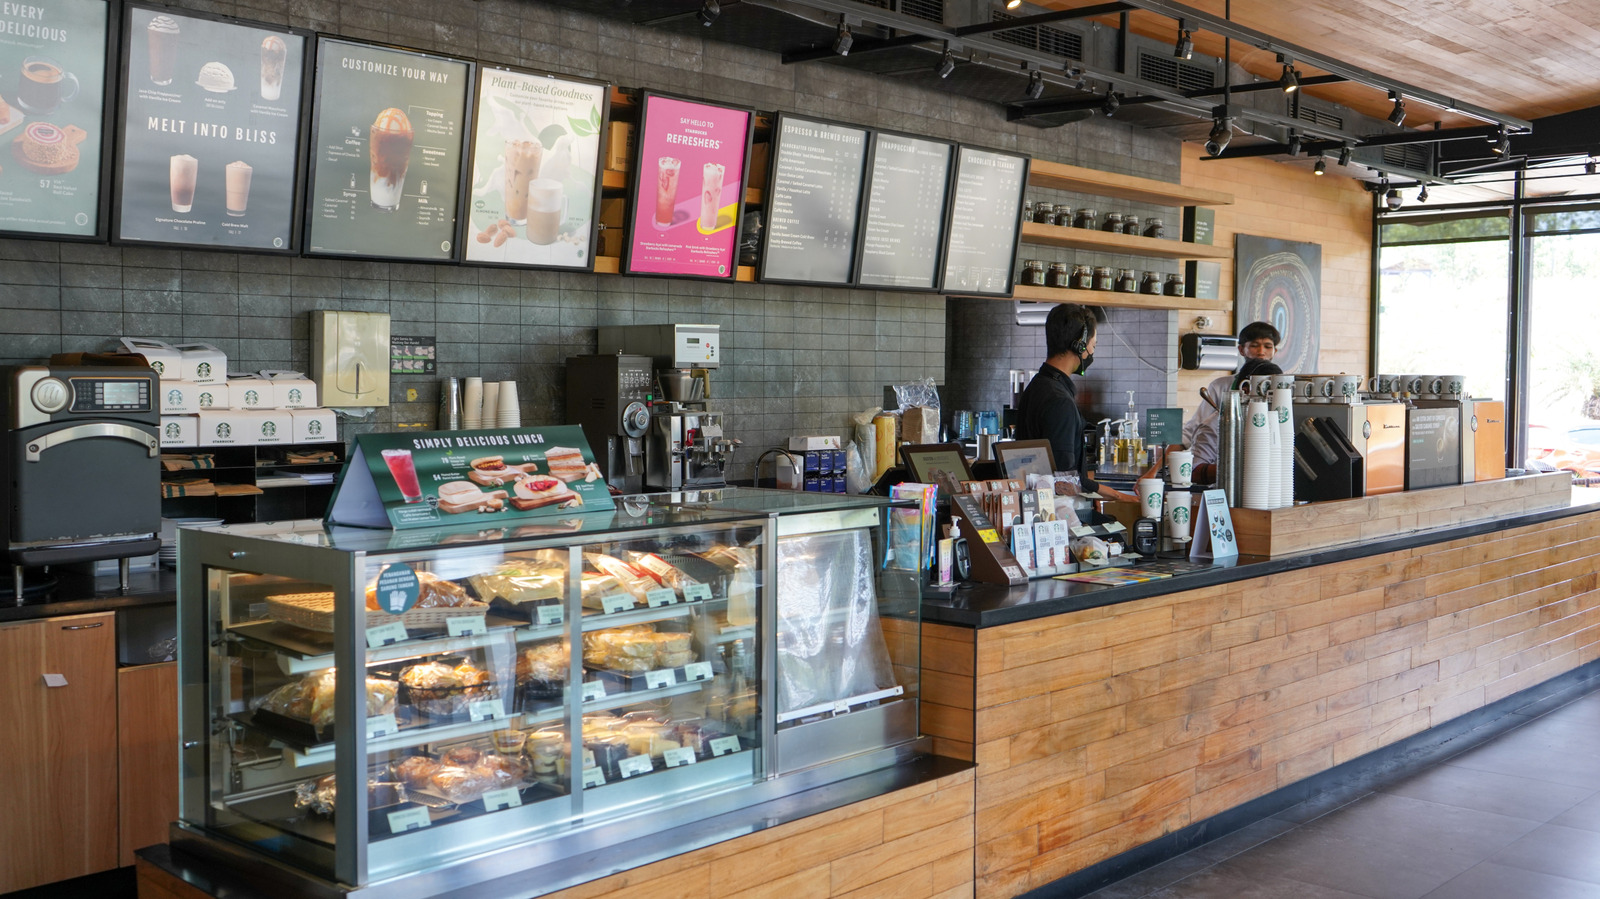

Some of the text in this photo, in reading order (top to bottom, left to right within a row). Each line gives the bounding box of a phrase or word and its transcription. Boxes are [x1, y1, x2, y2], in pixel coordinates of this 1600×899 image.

[3, 1, 45, 21] EVERY
[0, 20, 67, 43] DELICIOUS
[342, 57, 448, 84] CUSTOMIZE YOUR WAY
[491, 76, 594, 102] Plant-Based Goodness
[148, 116, 277, 145] MELT INTO BLISS
[690, 119, 706, 127] HELLO
[345, 138, 361, 146] Coffee
[666, 133, 720, 150] REFRESHERS
[784, 125, 860, 145] ESPRESSO & BREWED COFFEE
[422, 149, 446, 157] Sweetness
[881, 141, 915, 153] FRAPPUCCINO
[413, 433, 545, 449] SIMPLY DELICIOUS LUNCH
[383, 570, 411, 579] PENANGANAN
[398, 575, 415, 583] DENGAN
[380, 584, 398, 592] SARUNG
